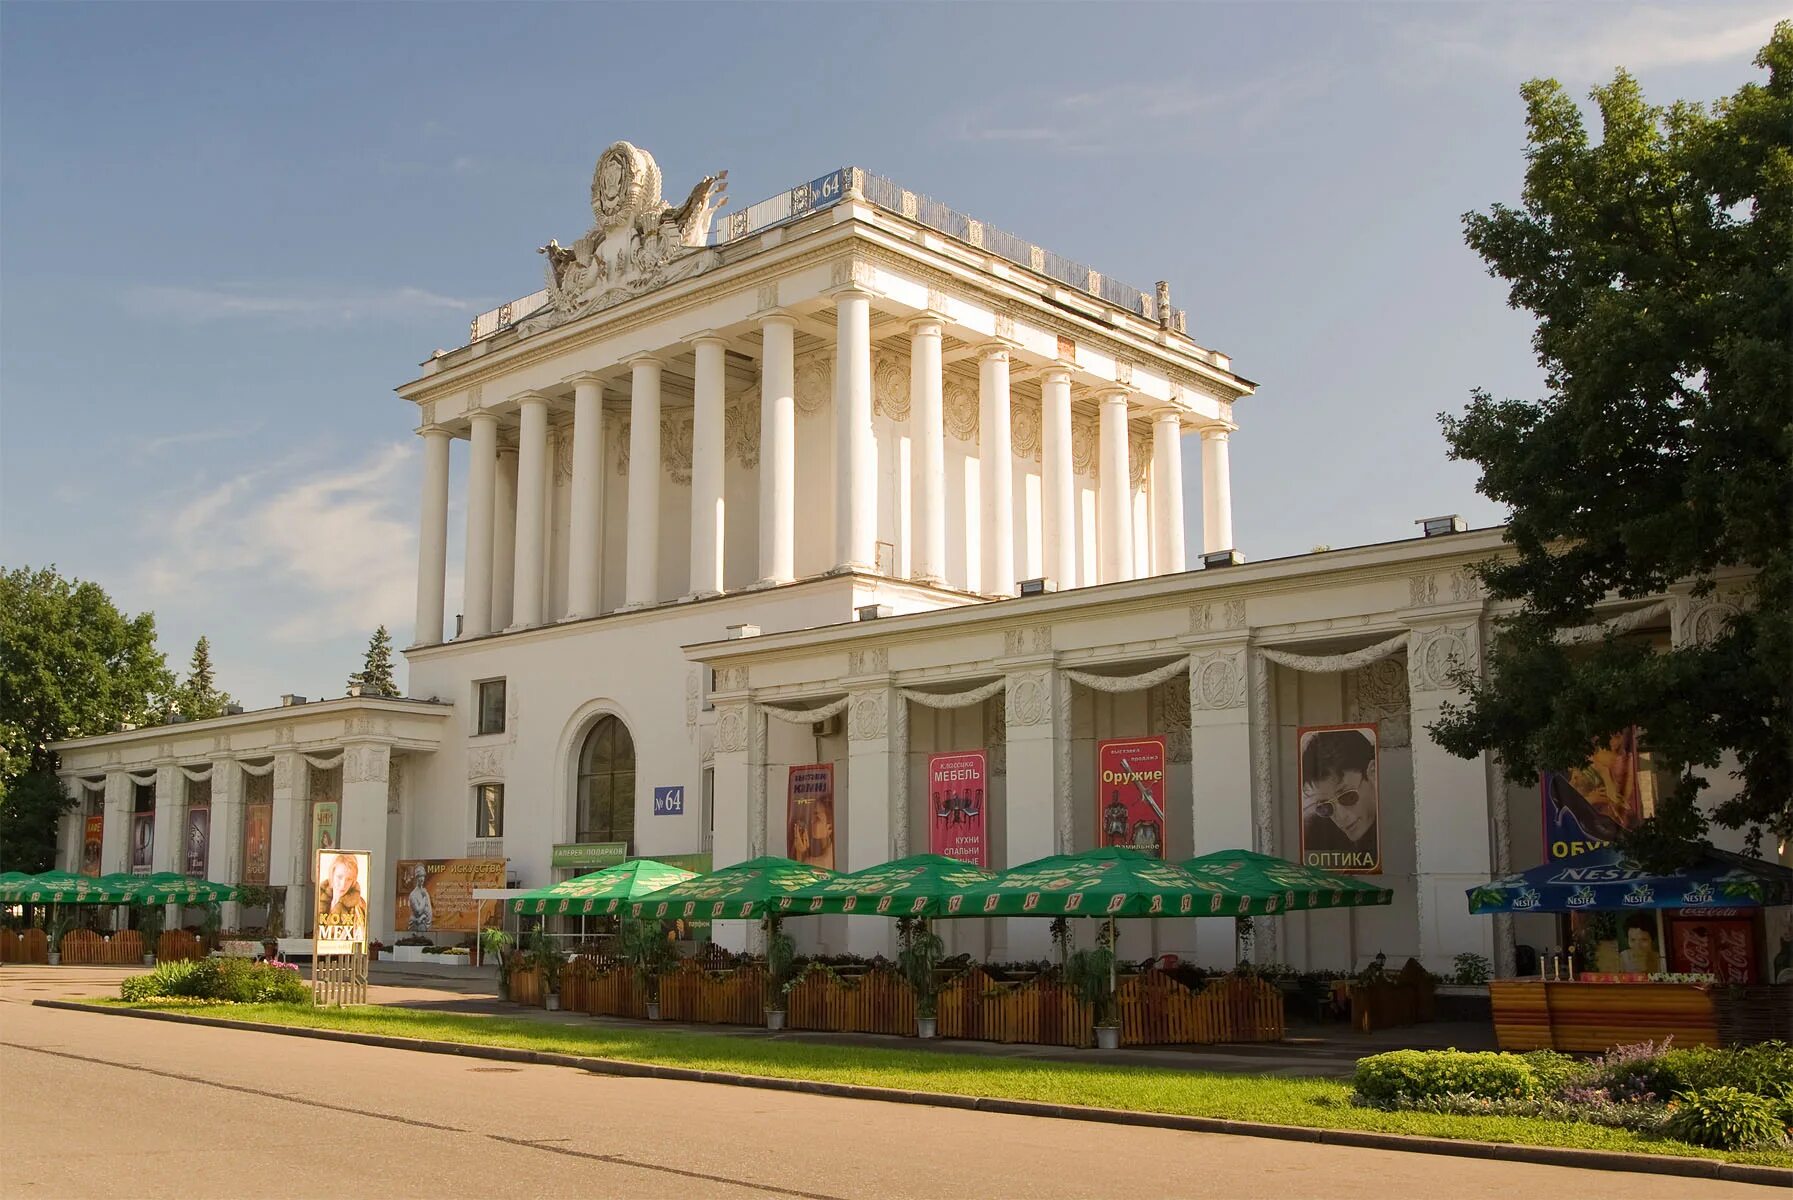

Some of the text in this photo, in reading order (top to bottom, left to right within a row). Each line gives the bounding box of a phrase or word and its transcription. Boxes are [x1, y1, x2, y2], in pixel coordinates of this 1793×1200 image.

[822, 174, 840, 198] 64
[934, 769, 980, 782] МЕБЕЛЬ
[1103, 770, 1163, 785] Оружие
[666, 789, 681, 811] 64
[955, 836, 980, 845] КУХНИ
[554, 847, 624, 857] ГАЛЕРЕЯ ПОДАРКОВ
[943, 847, 980, 856] СПАЛЬНИ
[1308, 852, 1375, 867] ОПТИКА
[427, 864, 503, 873] МИР ИСКУССТВА
[1624, 895, 1653, 905] NESTEA
[1683, 893, 1713, 903] NESTEA
[319, 925, 365, 940] МЕХА
